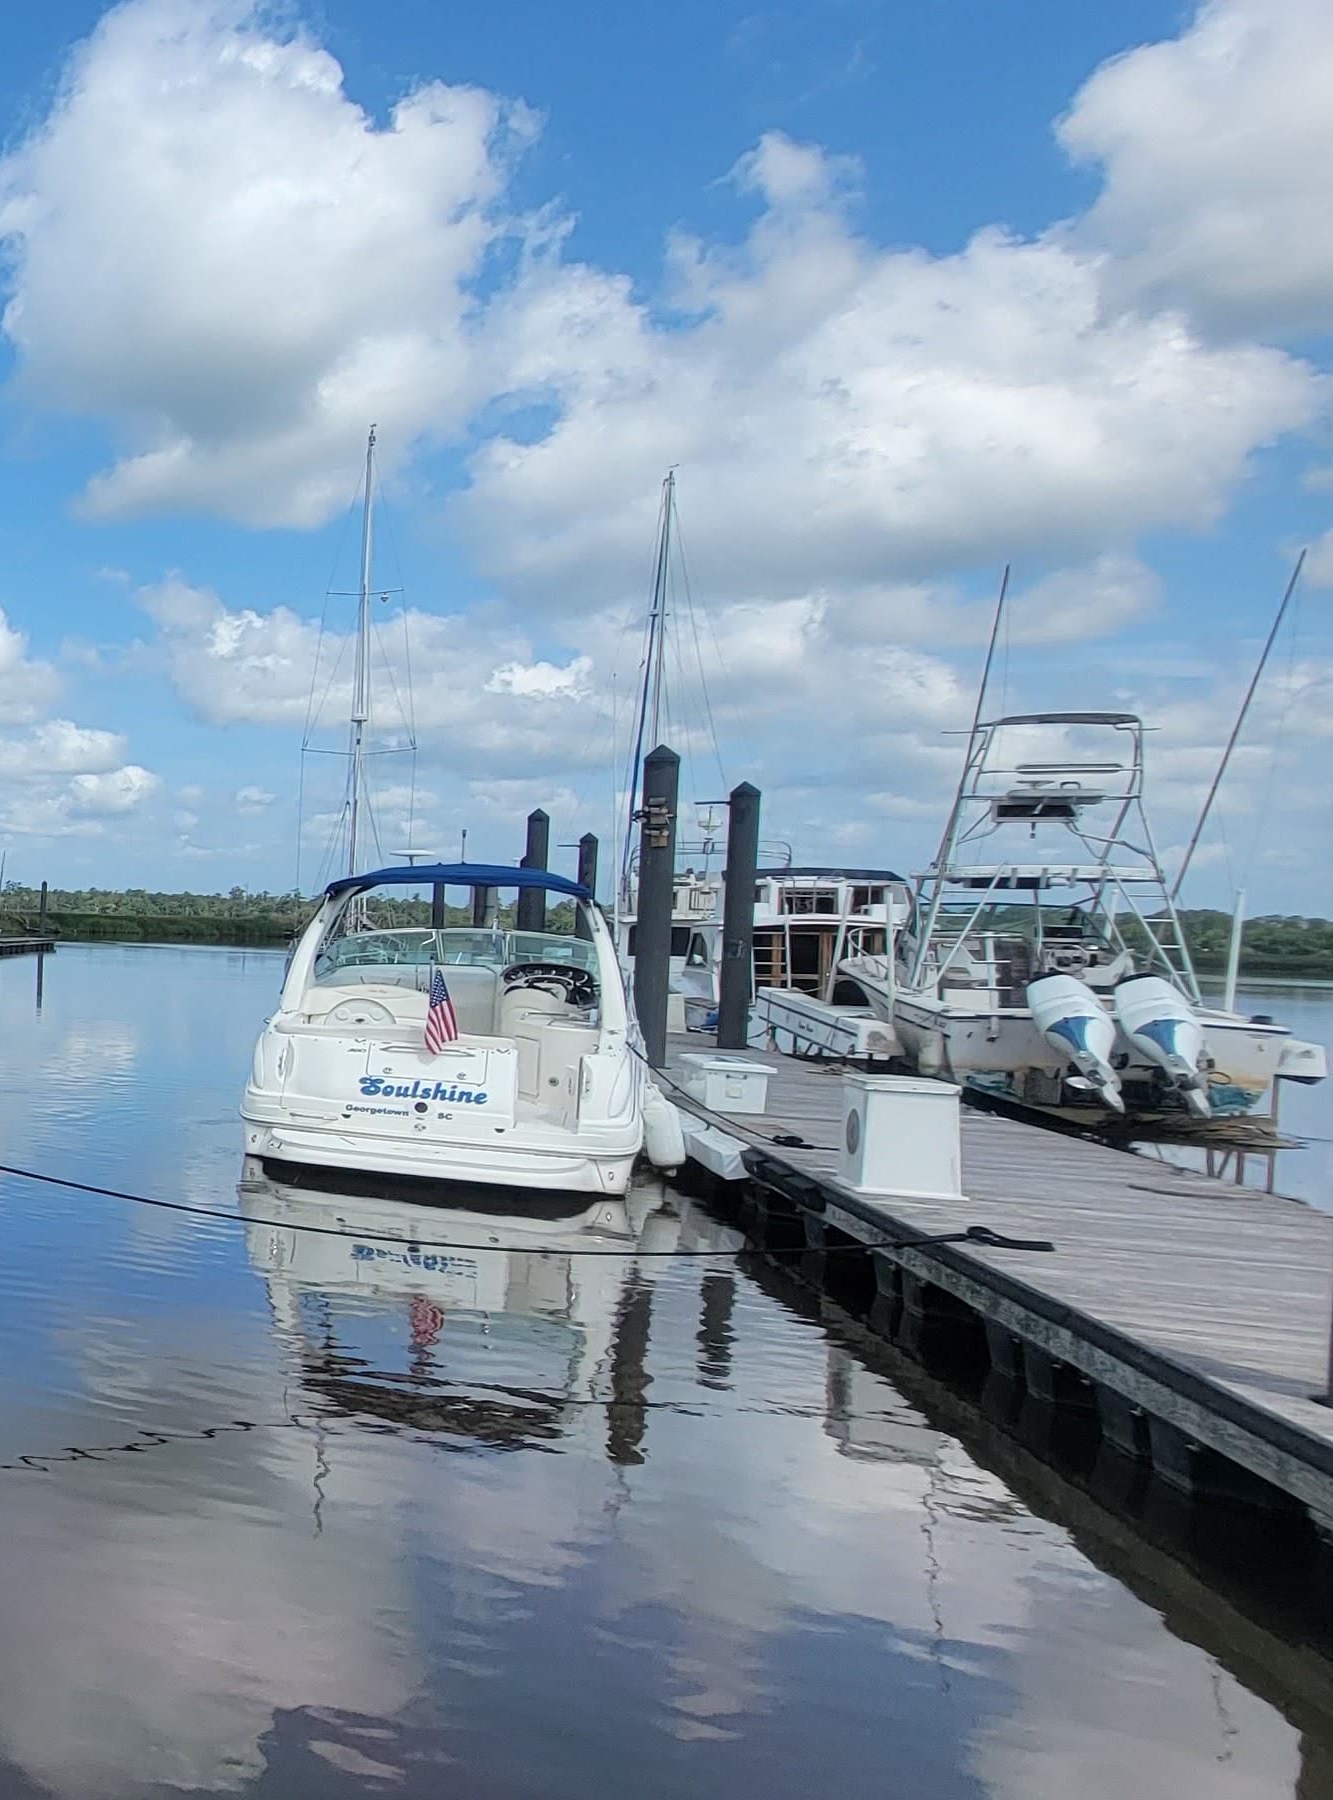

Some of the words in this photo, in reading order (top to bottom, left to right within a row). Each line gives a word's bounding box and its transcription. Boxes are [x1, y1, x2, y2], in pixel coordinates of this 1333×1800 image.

[358, 1076, 489, 1105] Soulshine
[345, 1104, 410, 1116] Georgetown
[437, 1112, 453, 1121] SC
